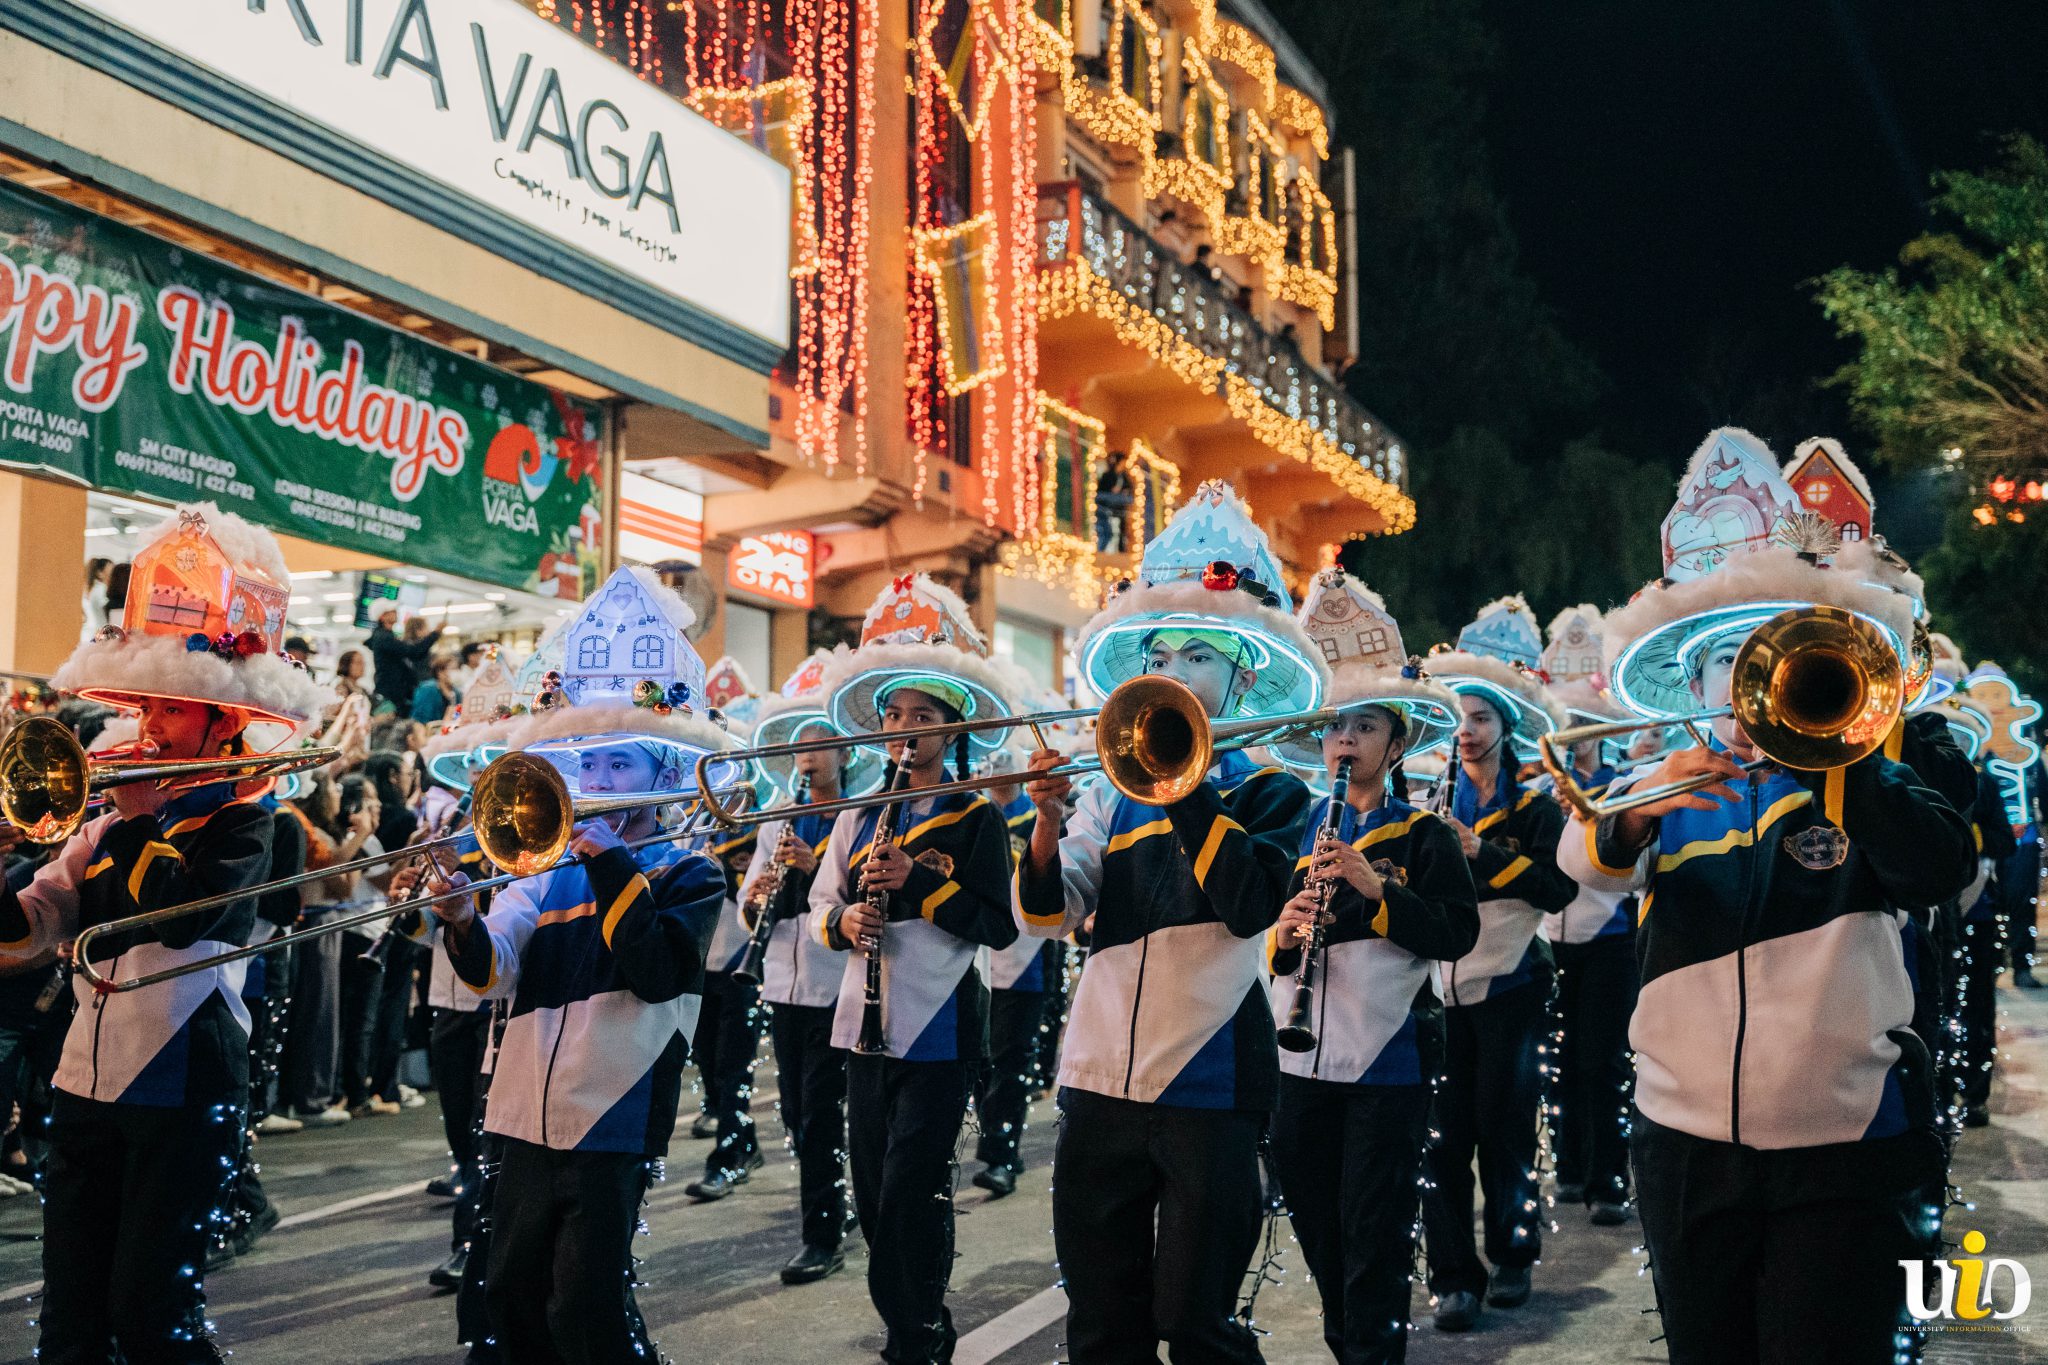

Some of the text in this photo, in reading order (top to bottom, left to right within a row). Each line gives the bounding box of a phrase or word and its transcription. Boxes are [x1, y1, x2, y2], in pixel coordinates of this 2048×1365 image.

[470, 22, 682, 234] VAGA
[157, 284, 468, 501] Holidays
[0, 400, 89, 439] PORTA VAGA
[12, 424, 37, 444] 444
[39, 430, 73, 453] 3600
[139, 437, 237, 478] SM CITY BAGUIO
[312, 488, 357, 512] SESSION
[482, 476, 540, 537] PORTA VAGA
[736, 537, 809, 583] 24
[736, 567, 807, 599] ORAS
